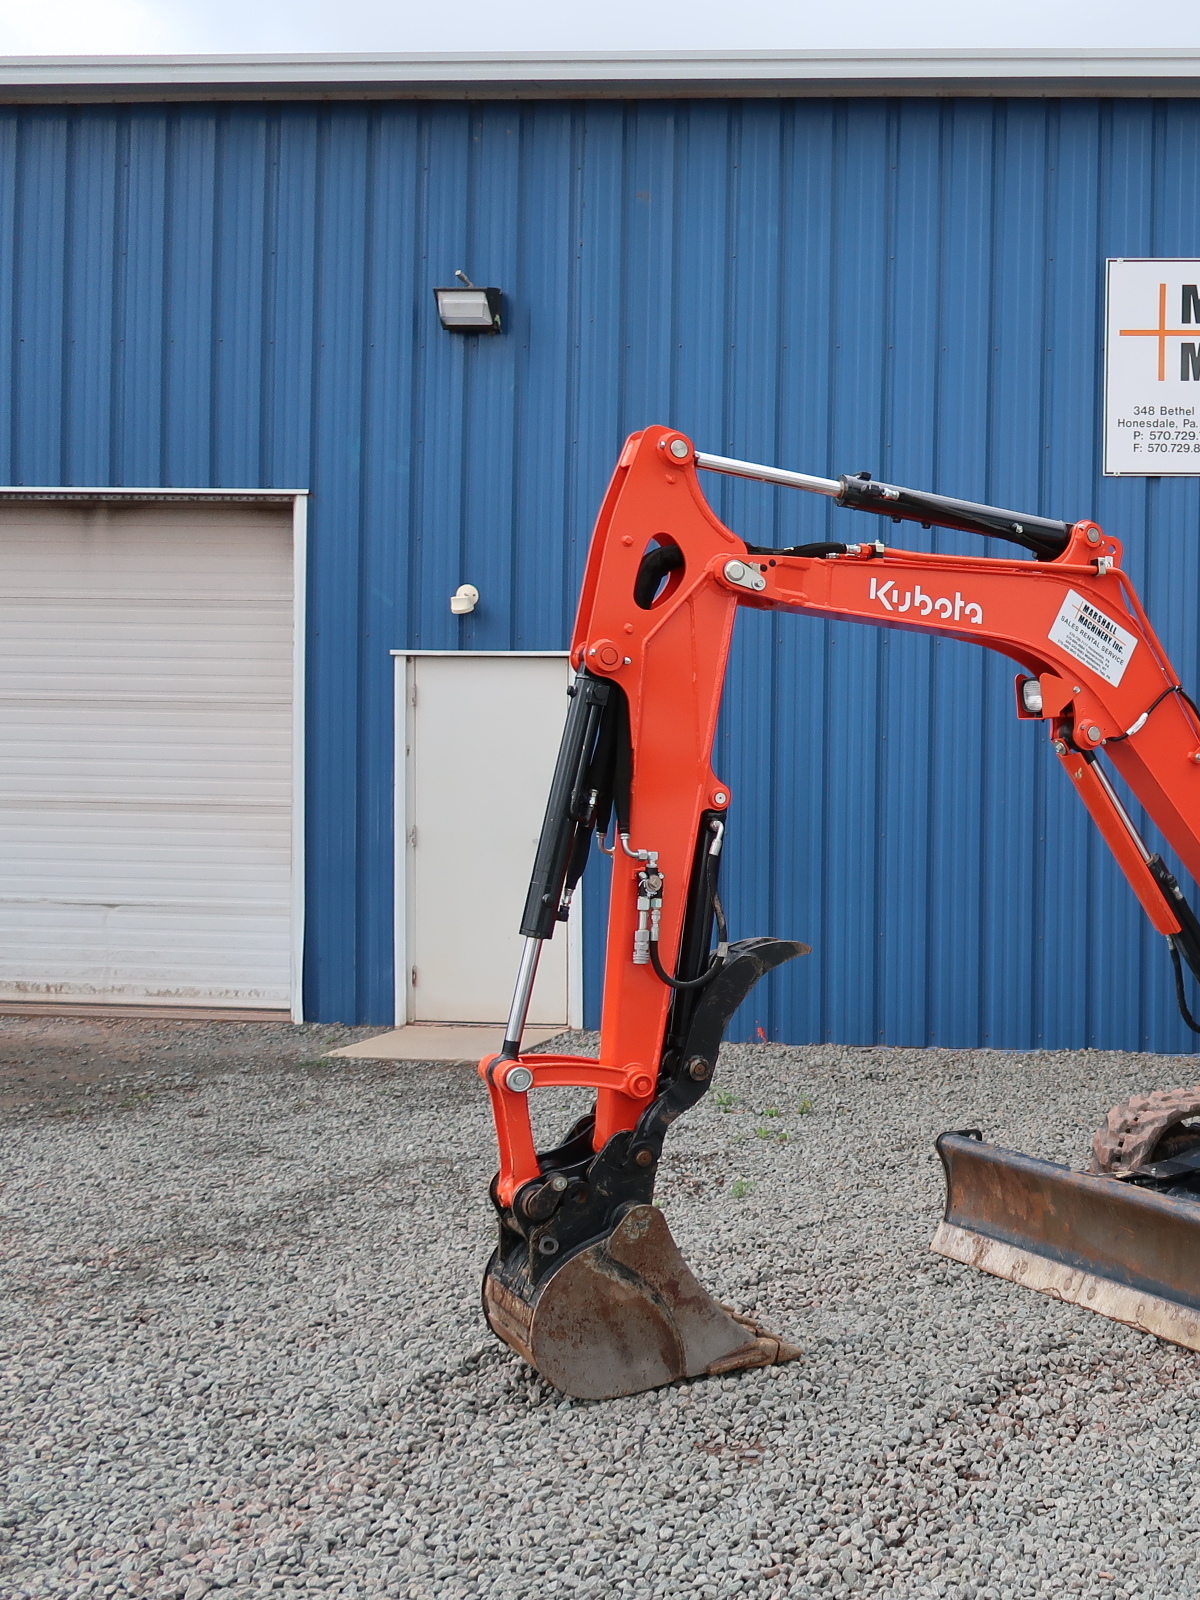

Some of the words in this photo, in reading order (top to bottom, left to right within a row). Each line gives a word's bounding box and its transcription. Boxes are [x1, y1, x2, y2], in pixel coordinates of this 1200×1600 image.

[1133, 405, 1155, 416] 348
[1160, 406, 1195, 416] Bethel
[1117, 418, 1178, 429] Honesdale,
[1183, 418, 1199, 428] Pa.
[1133, 430, 1144, 440] P:
[1133, 443, 1143, 453] F:
[869, 577, 983, 625] Kubota
[1082, 604, 1117, 635] MARSHALL
[1060, 616, 1079, 632] SALES
[1080, 630, 1100, 648] RENTAL
[1101, 645, 1124, 666] SERVICE
